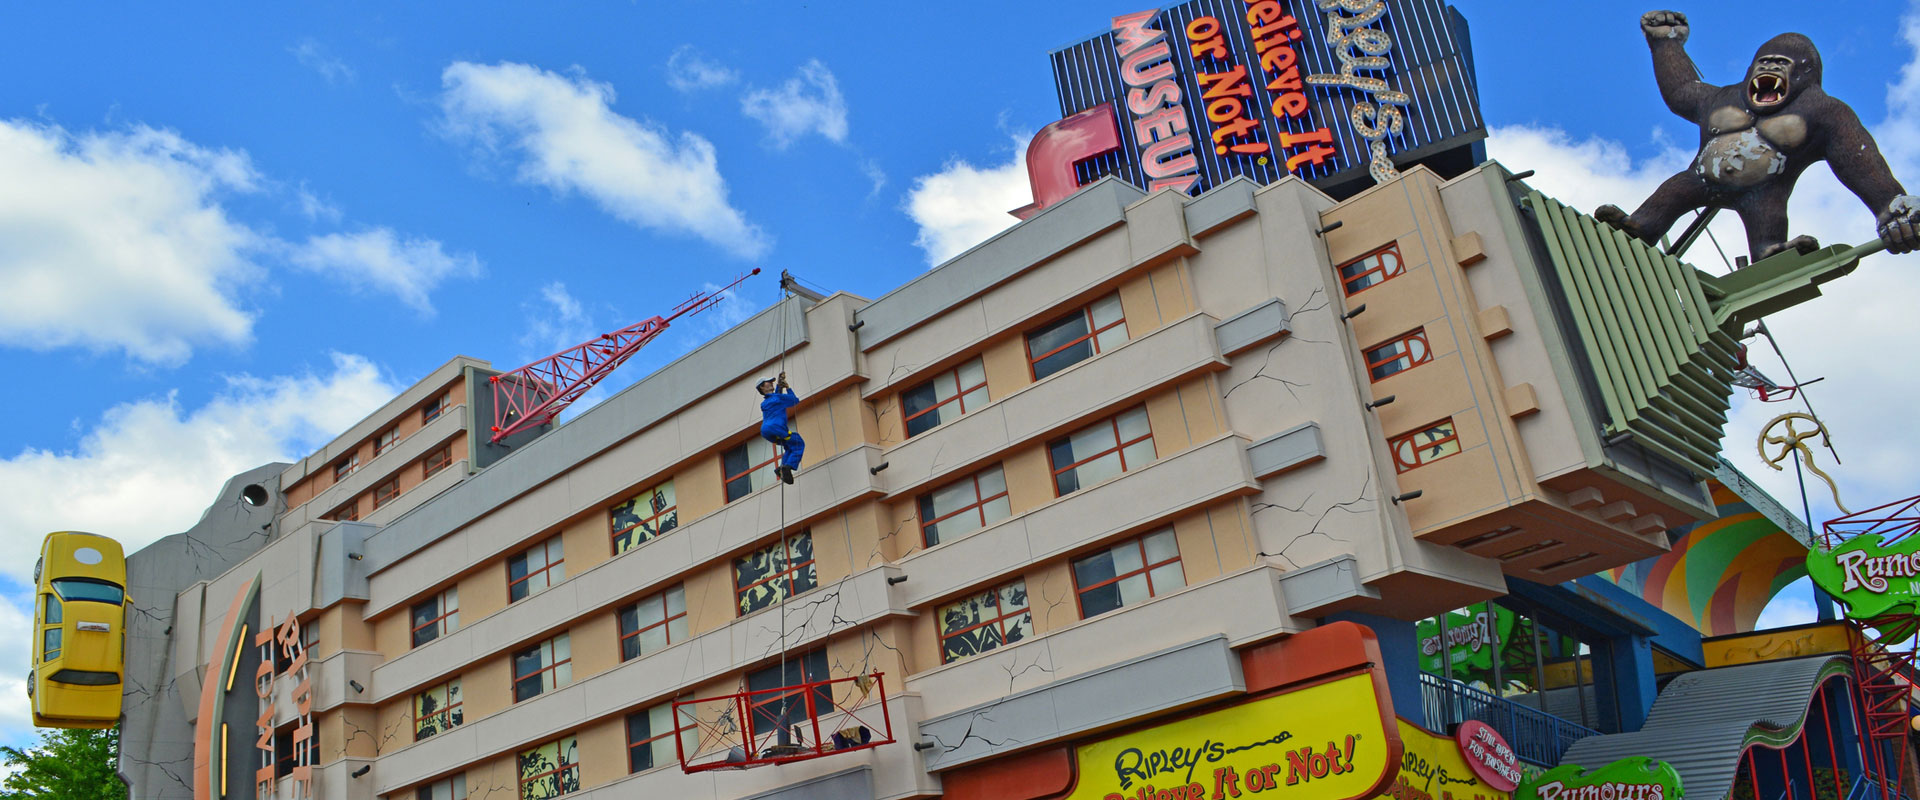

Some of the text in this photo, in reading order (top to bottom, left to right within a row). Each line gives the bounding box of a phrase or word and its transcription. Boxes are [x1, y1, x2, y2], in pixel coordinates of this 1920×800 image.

[1186, 15, 1269, 158] or Not!
[1245, 0, 1337, 174] elieve It
[1212, 766, 1243, 800] It
[1245, 763, 1281, 791] or
[1286, 734, 1356, 787] Not!
[1469, 740, 1484, 760] FOR
